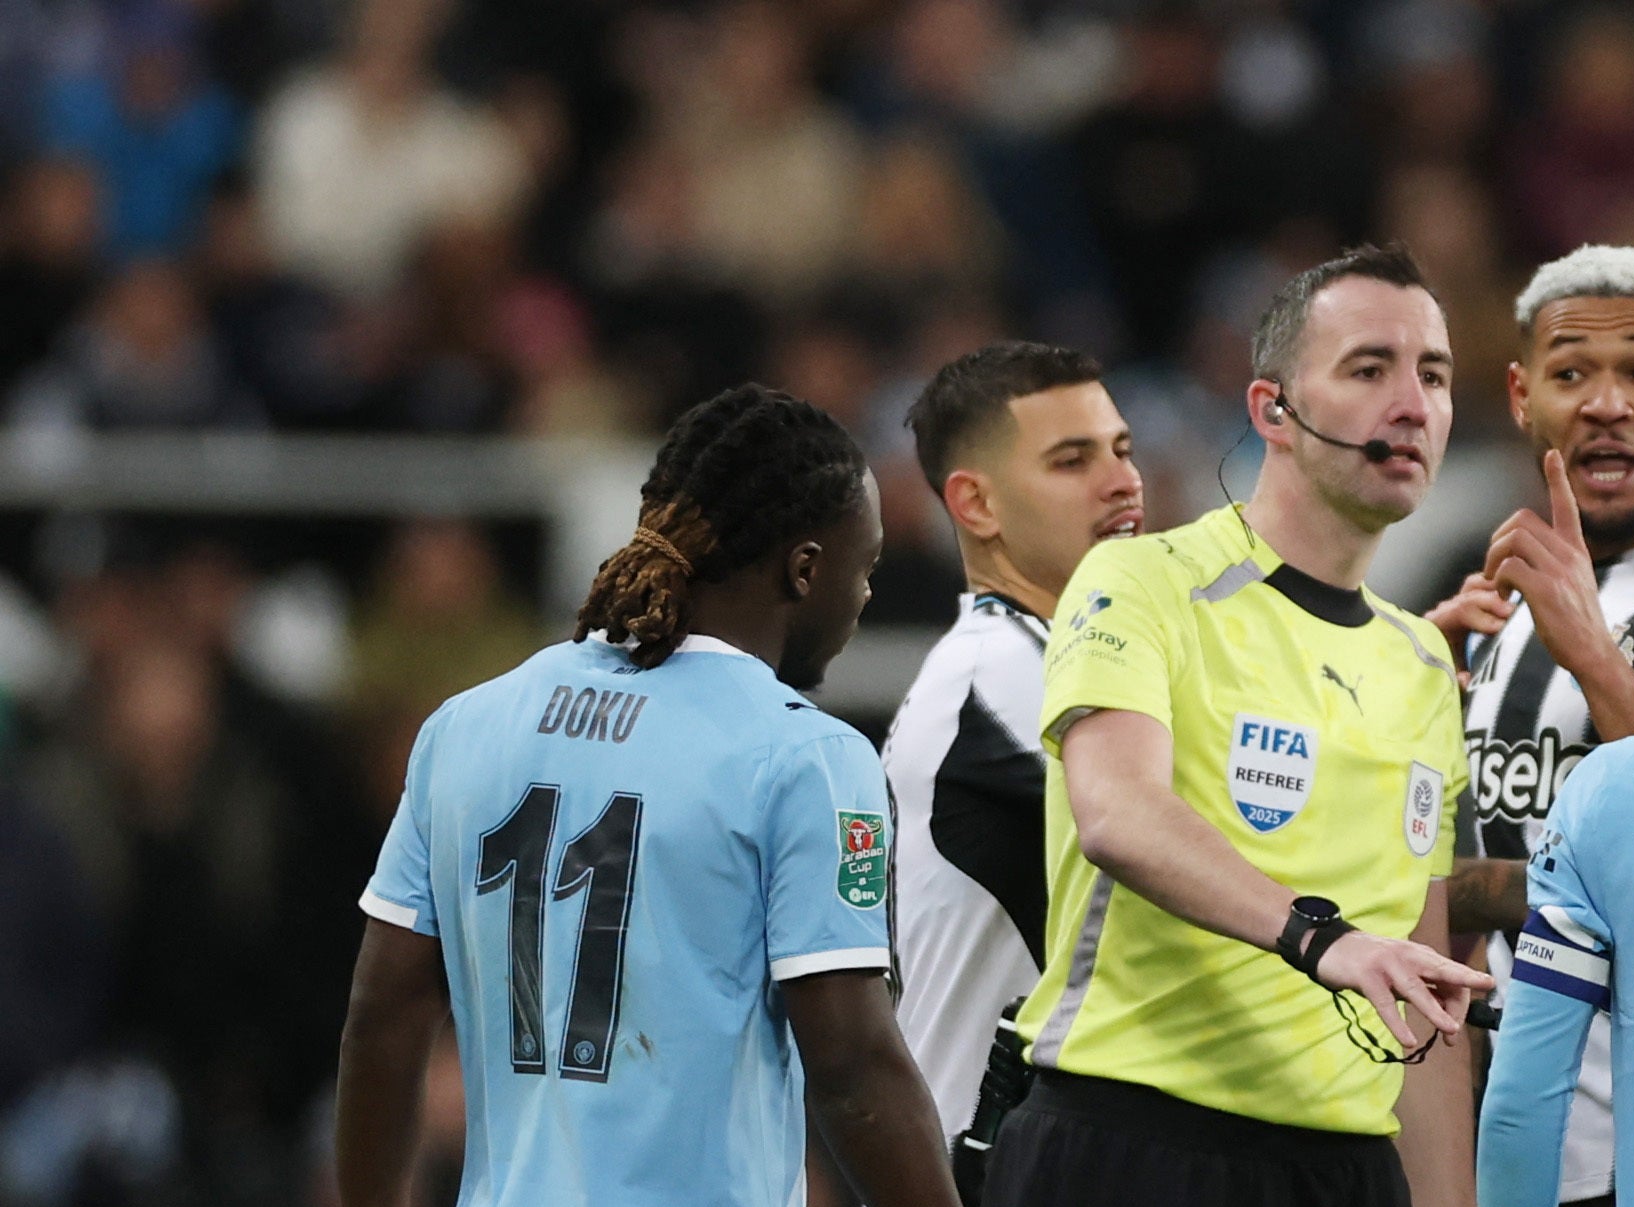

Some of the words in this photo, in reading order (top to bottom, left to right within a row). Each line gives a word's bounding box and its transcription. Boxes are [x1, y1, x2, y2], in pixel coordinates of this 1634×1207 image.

[537, 685, 649, 744] DOKU
[1239, 721, 1309, 759] FIFA
[1235, 766, 1305, 792] REFEREE
[1247, 806, 1282, 825] 2025
[1411, 818, 1428, 839] EFL
[848, 861, 872, 874] Cup
[475, 783, 643, 1084] 11
[1516, 939, 1554, 962] APTAIN
